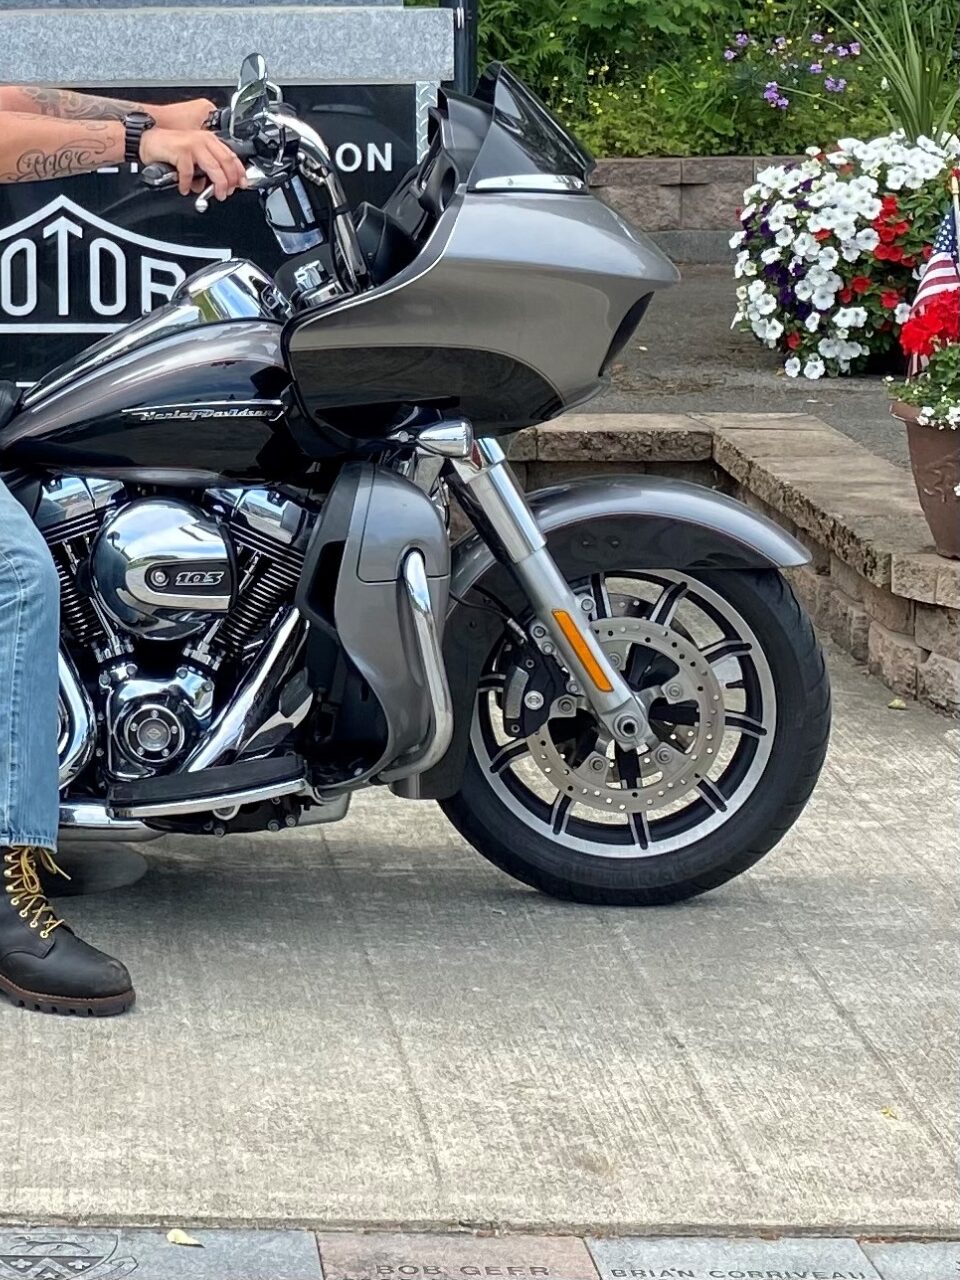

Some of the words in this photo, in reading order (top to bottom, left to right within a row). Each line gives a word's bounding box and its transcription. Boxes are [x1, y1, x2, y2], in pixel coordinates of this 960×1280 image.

[175, 571, 225, 585] 103
[375, 1265, 441, 1275] BOB
[460, 1265, 549, 1276] GEER
[611, 1269, 696, 1278] BRIAN
[708, 1270, 866, 1280] CORRIVEAU
